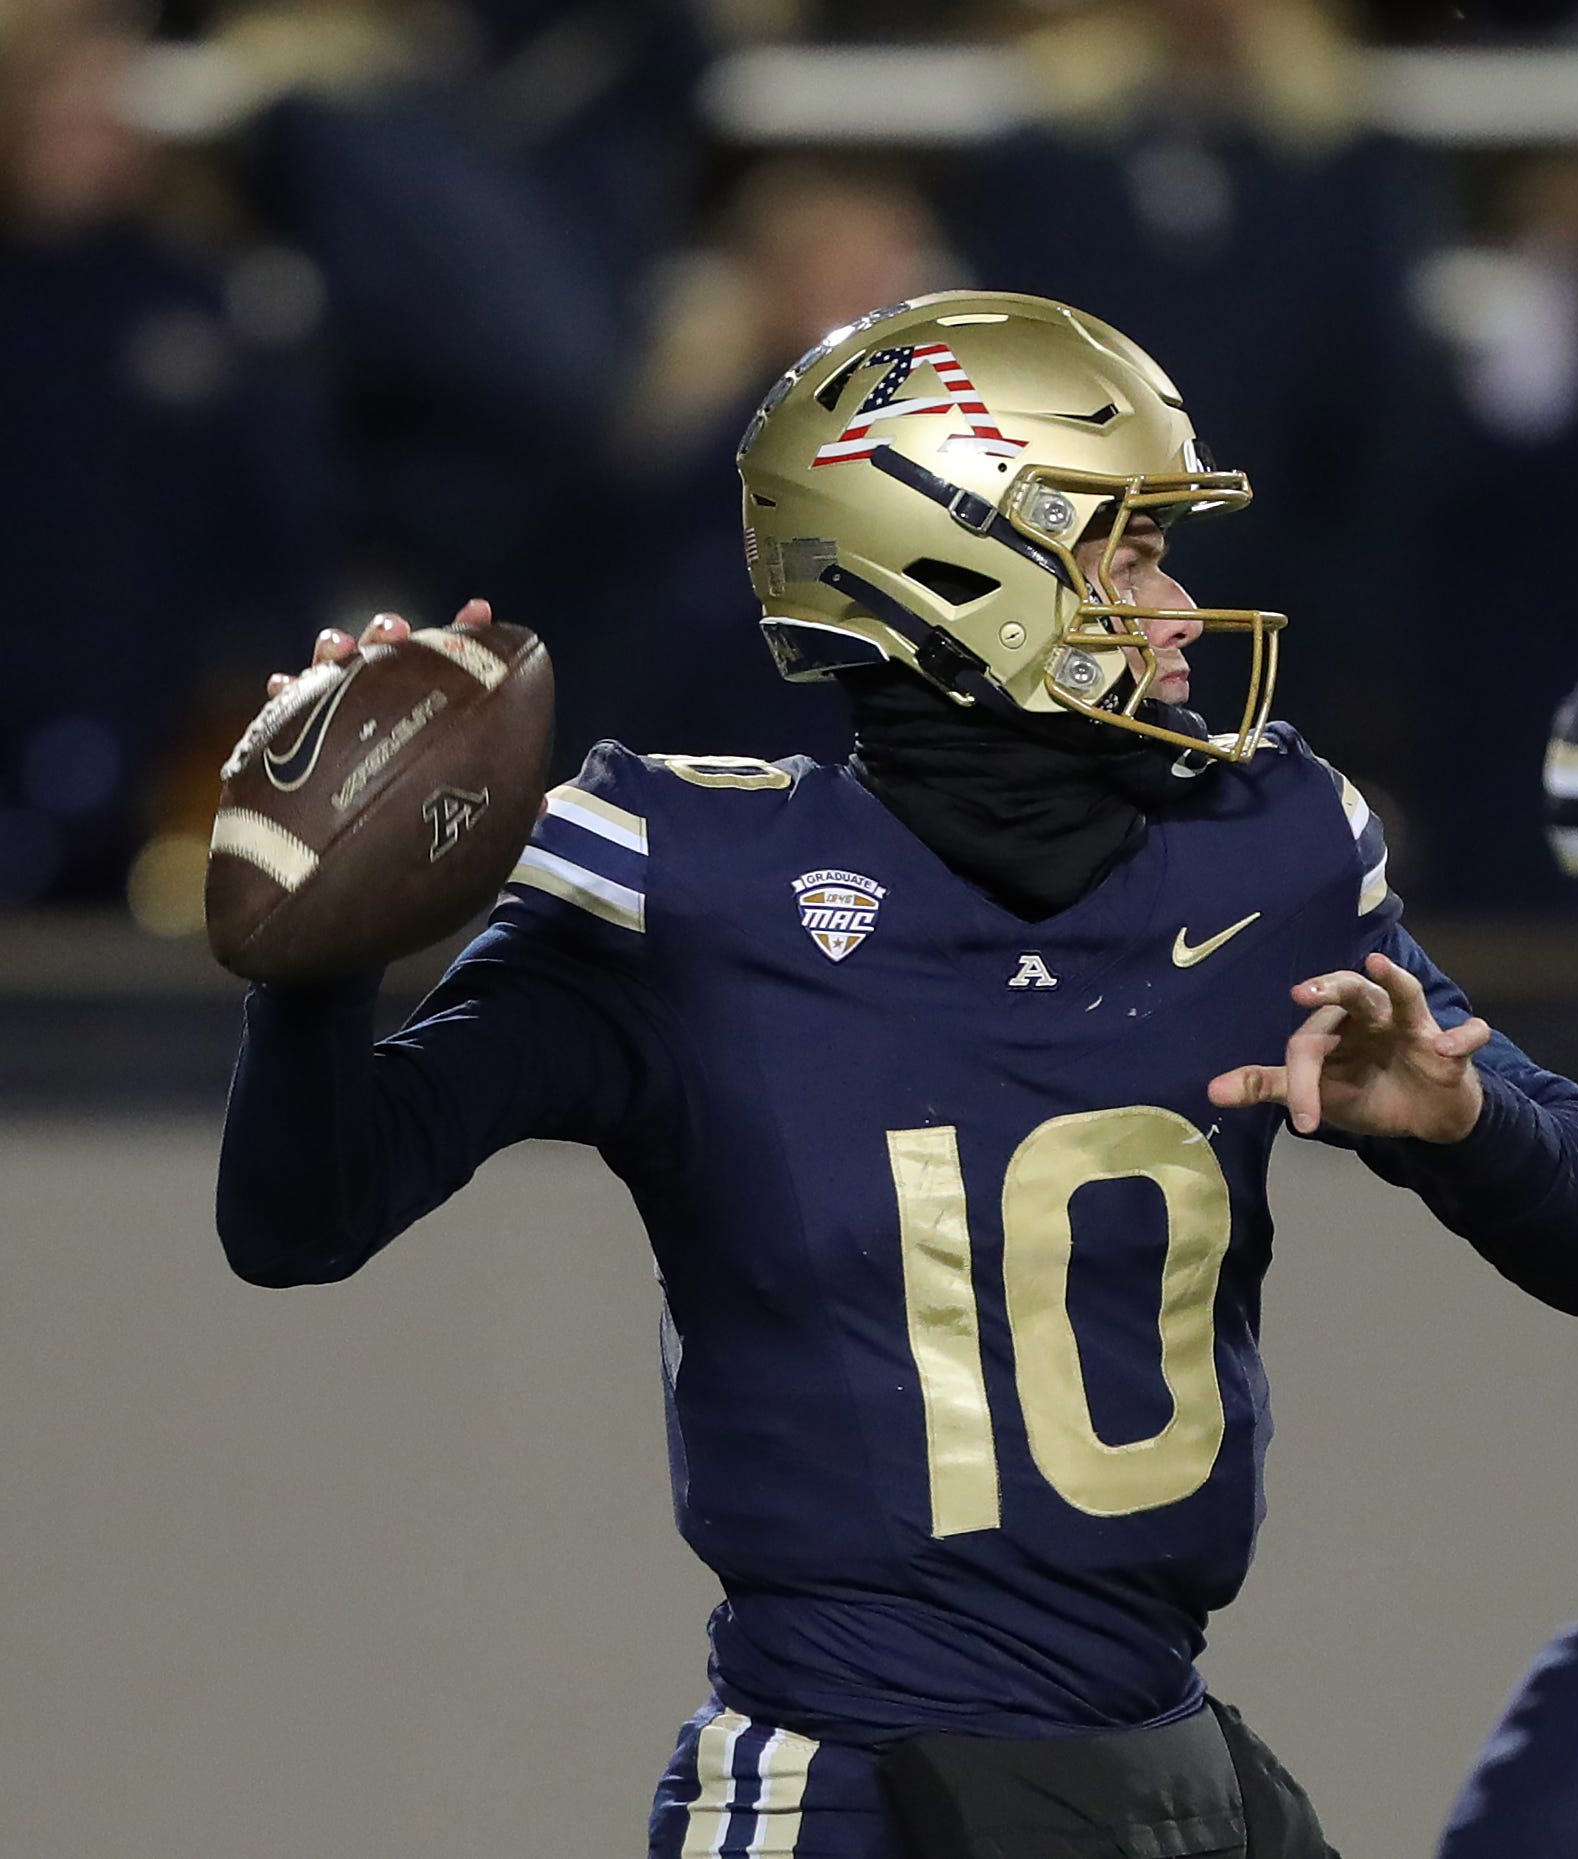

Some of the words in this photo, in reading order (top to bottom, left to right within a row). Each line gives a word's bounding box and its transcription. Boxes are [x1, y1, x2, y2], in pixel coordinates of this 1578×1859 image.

[808, 342, 1030, 470] A
[422, 783, 490, 864] A
[805, 871, 872, 890] GRADUATE
[801, 908, 876, 932] MAC
[1007, 954, 1058, 988] A
[886, 1104, 1232, 1540] 10
